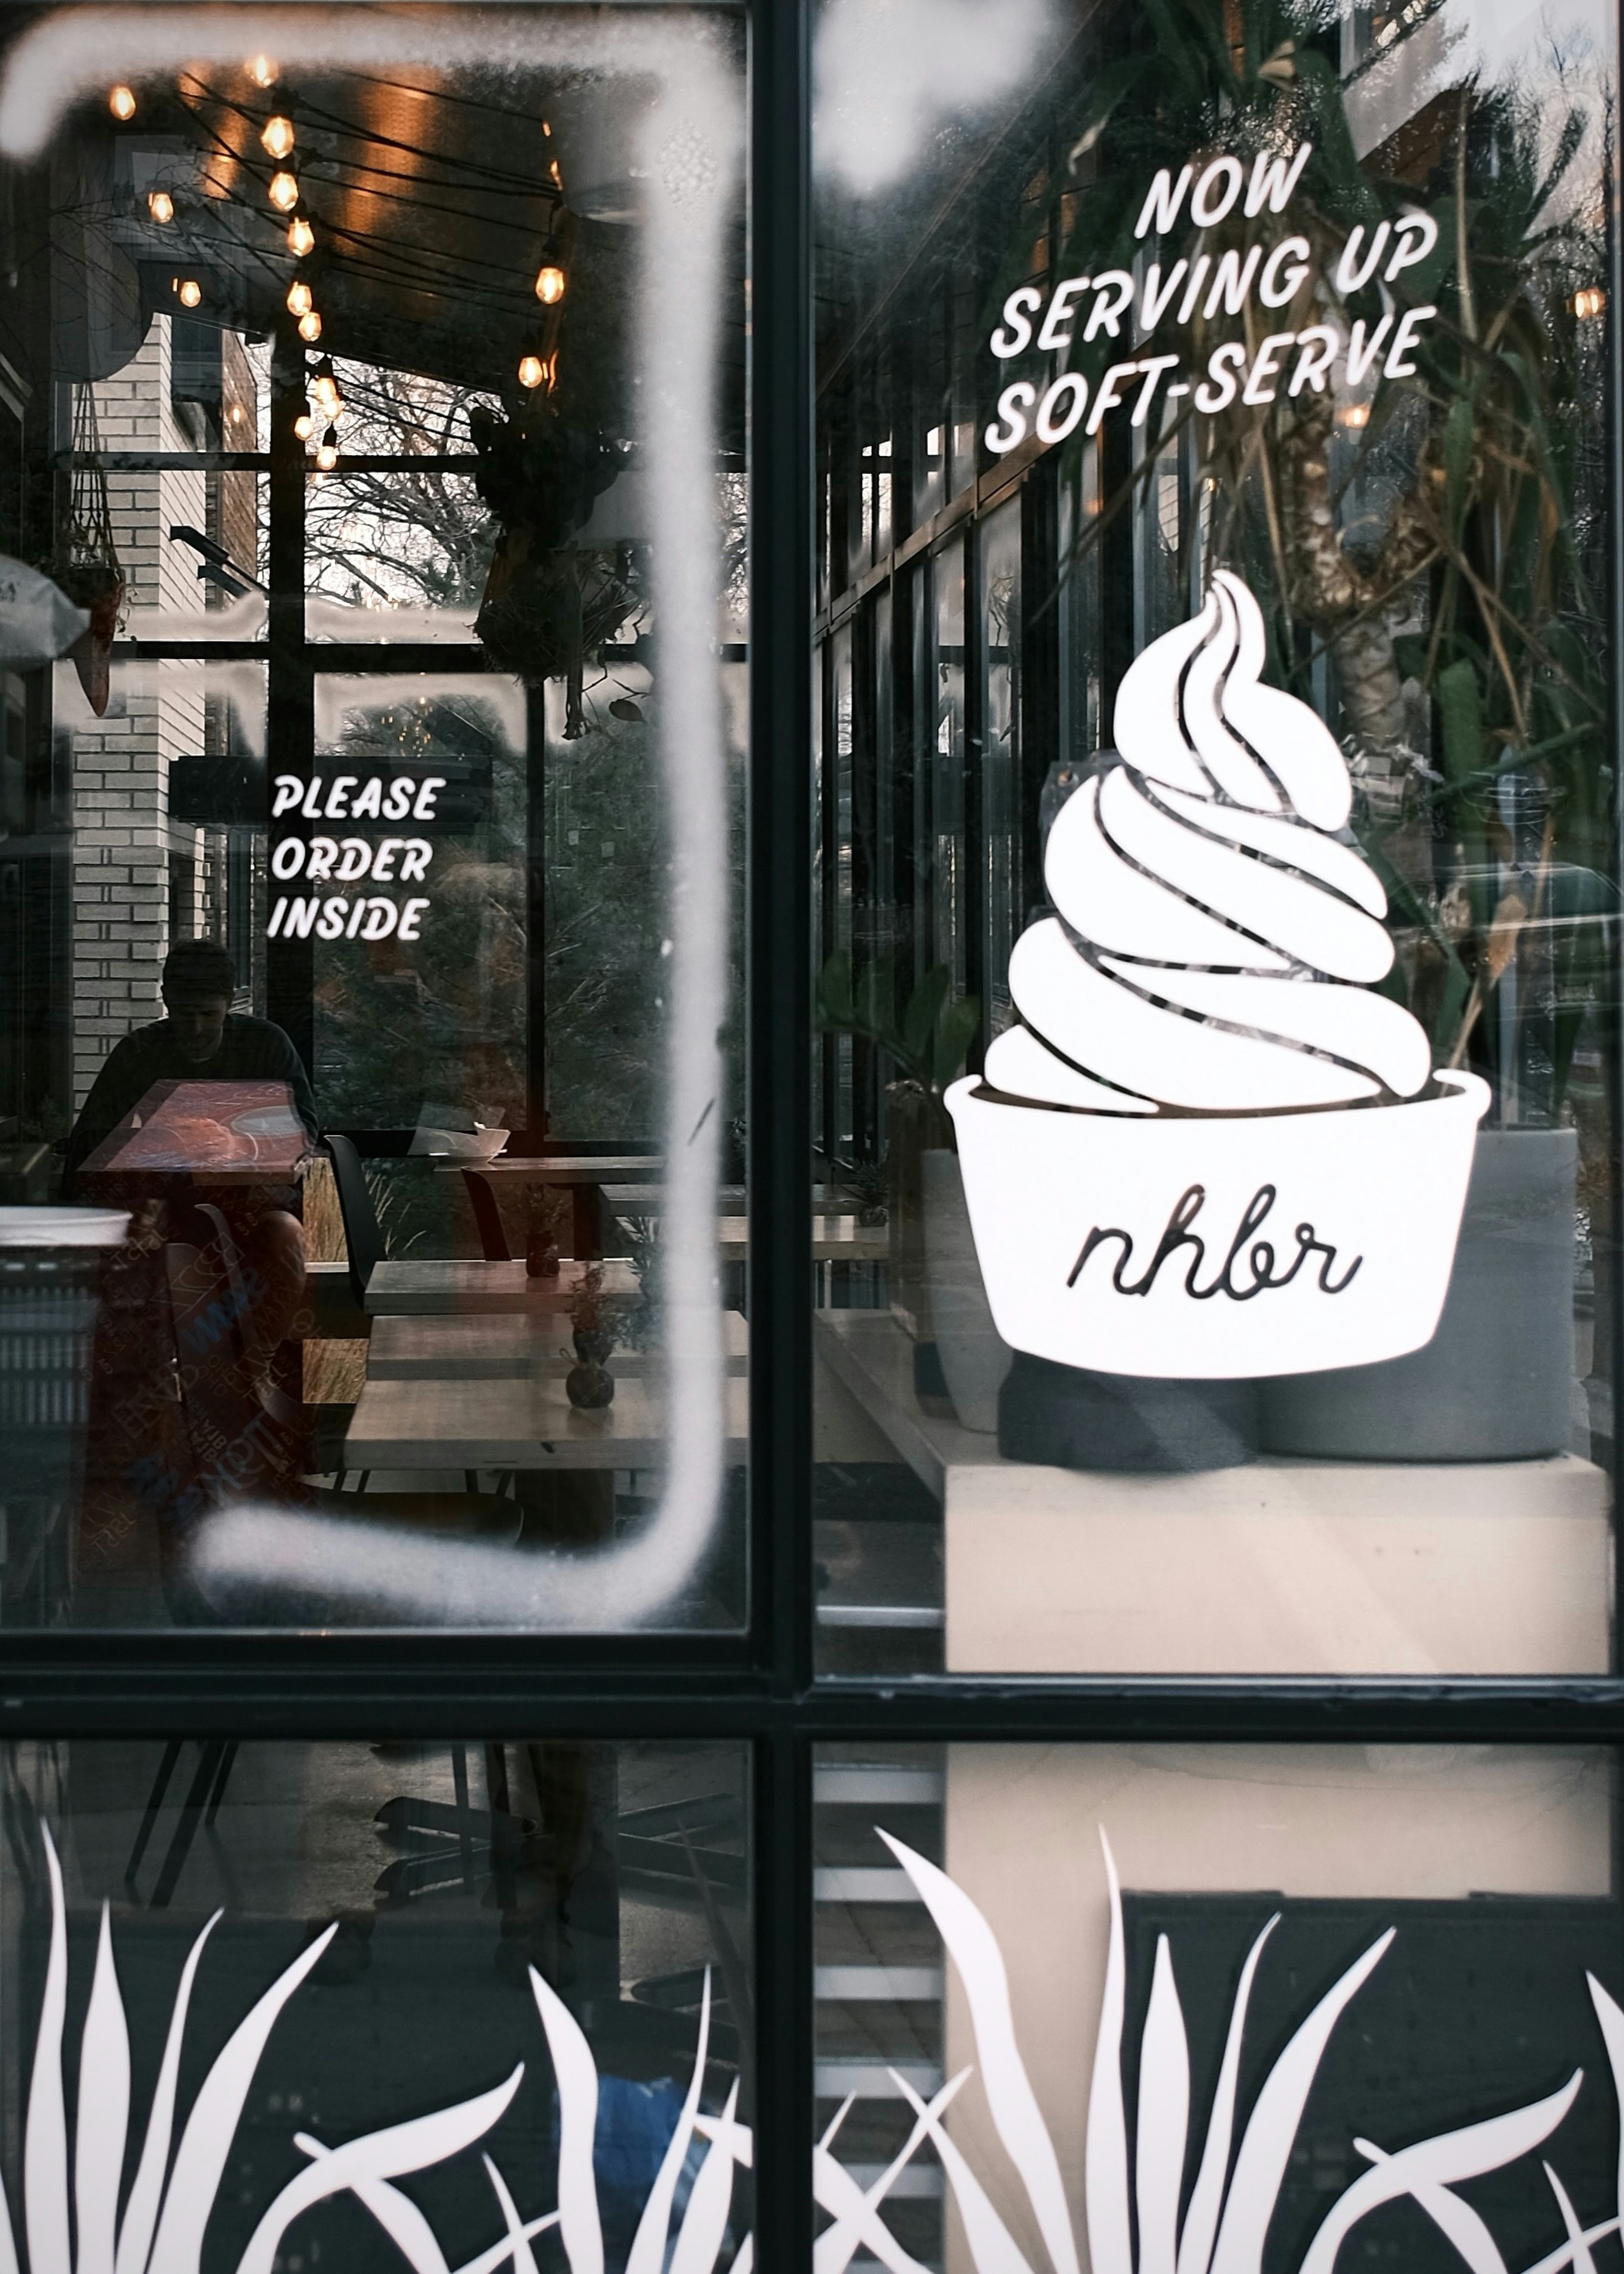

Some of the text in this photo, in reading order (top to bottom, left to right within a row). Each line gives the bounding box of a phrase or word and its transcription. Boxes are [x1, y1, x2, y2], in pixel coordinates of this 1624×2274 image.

[1134, 142, 1311, 239] NOW
[990, 213, 1438, 359] SERVING UP
[984, 306, 1437, 454] SOFT-SERVE
[272, 775, 447, 820] PLEASE
[271, 837, 433, 881] ORDER
[267, 896, 430, 940] INSIDE
[1067, 1184, 1364, 1300] nhbr
